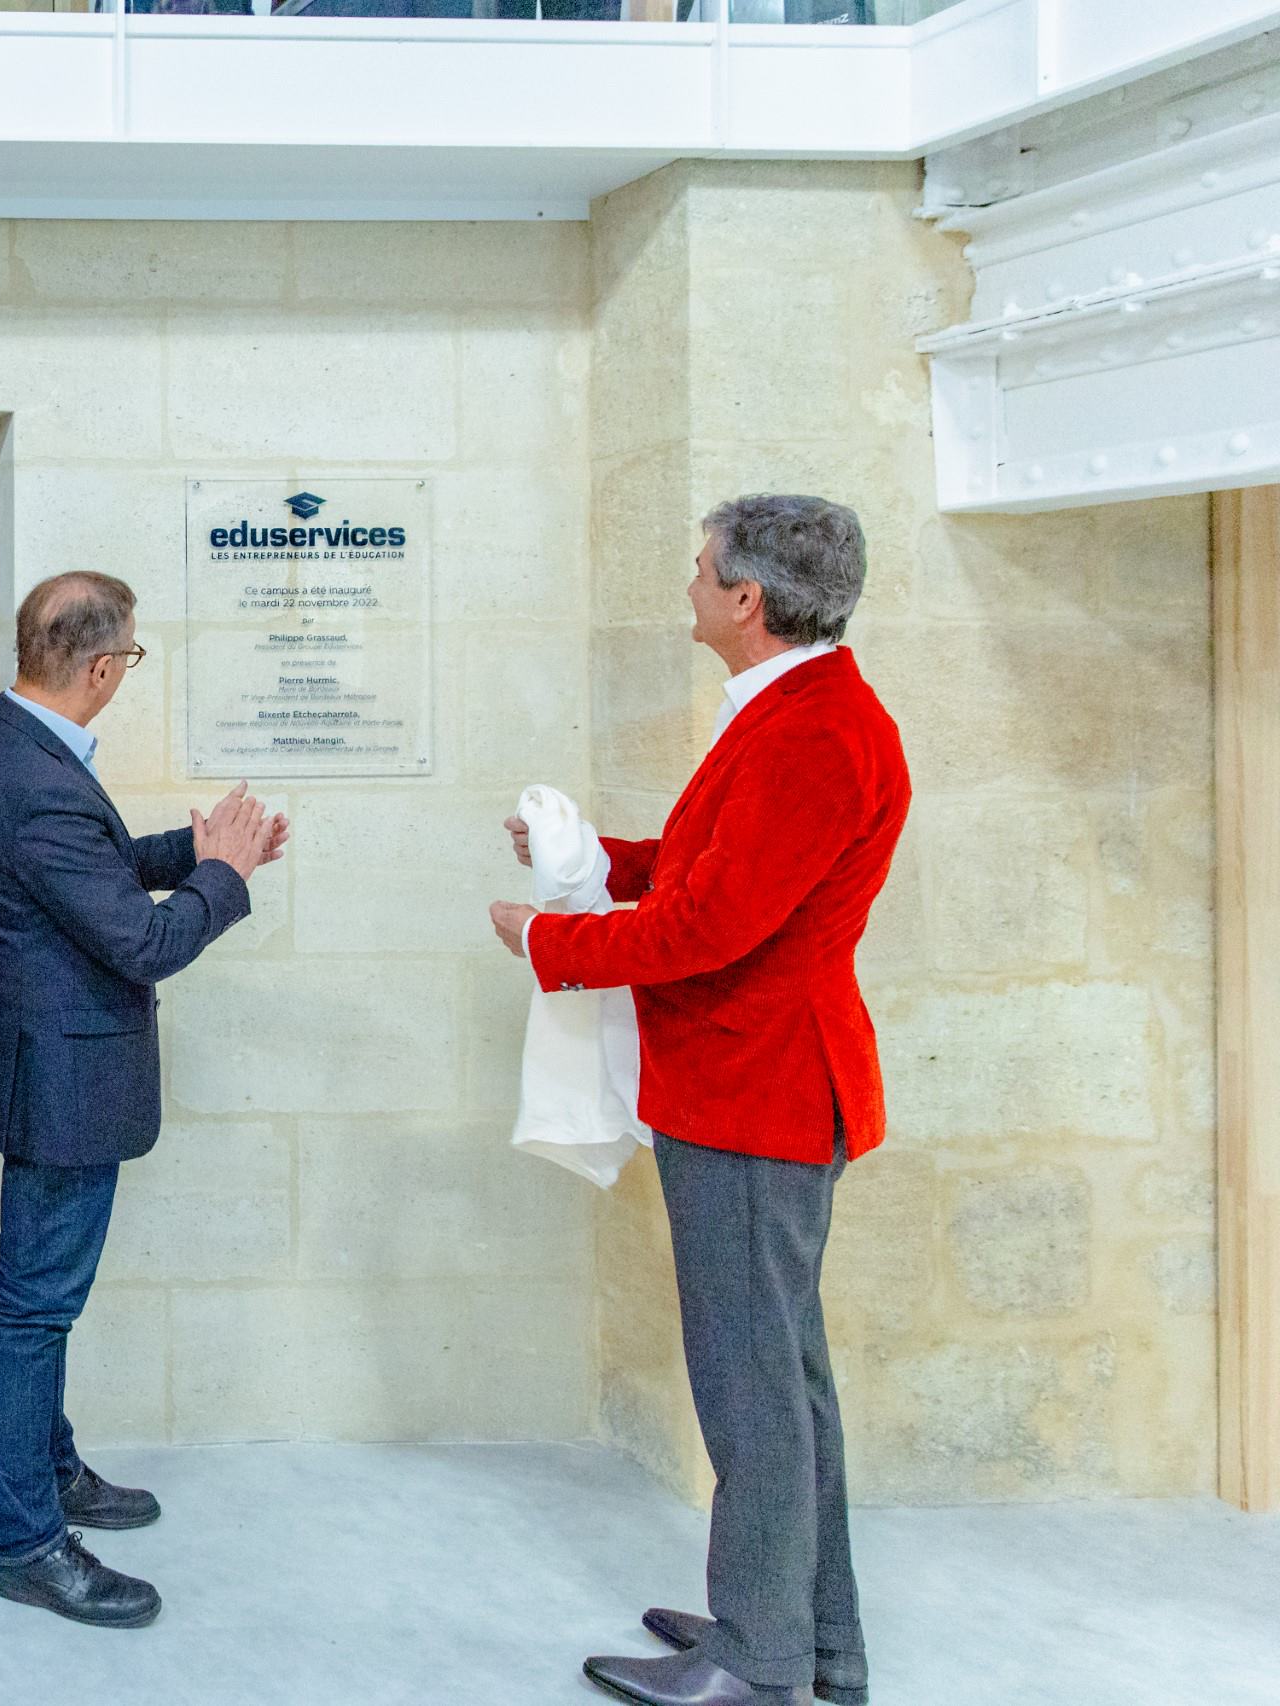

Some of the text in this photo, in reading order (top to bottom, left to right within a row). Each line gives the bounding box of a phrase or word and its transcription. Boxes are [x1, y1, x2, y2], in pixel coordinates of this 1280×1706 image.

[210, 520, 406, 548] eduservices
[211, 551, 230, 560] LES
[234, 551, 320, 560] ENTREPRENEURS
[324, 551, 337, 559] DE
[245, 586, 258, 595] Ce
[261, 587, 300, 597] campus
[310, 586, 327, 595] été
[329, 585, 372, 597] inauguré
[239, 599, 248, 608] le
[251, 599, 280, 608] mardi
[283, 599, 295, 607] 22
[298, 598, 350, 607] novembre
[269, 633, 305, 643] Philippe
[279, 676, 304, 684] Pierre
[258, 710, 291, 719] Bixente
[273, 736, 311, 745] Matthieu
